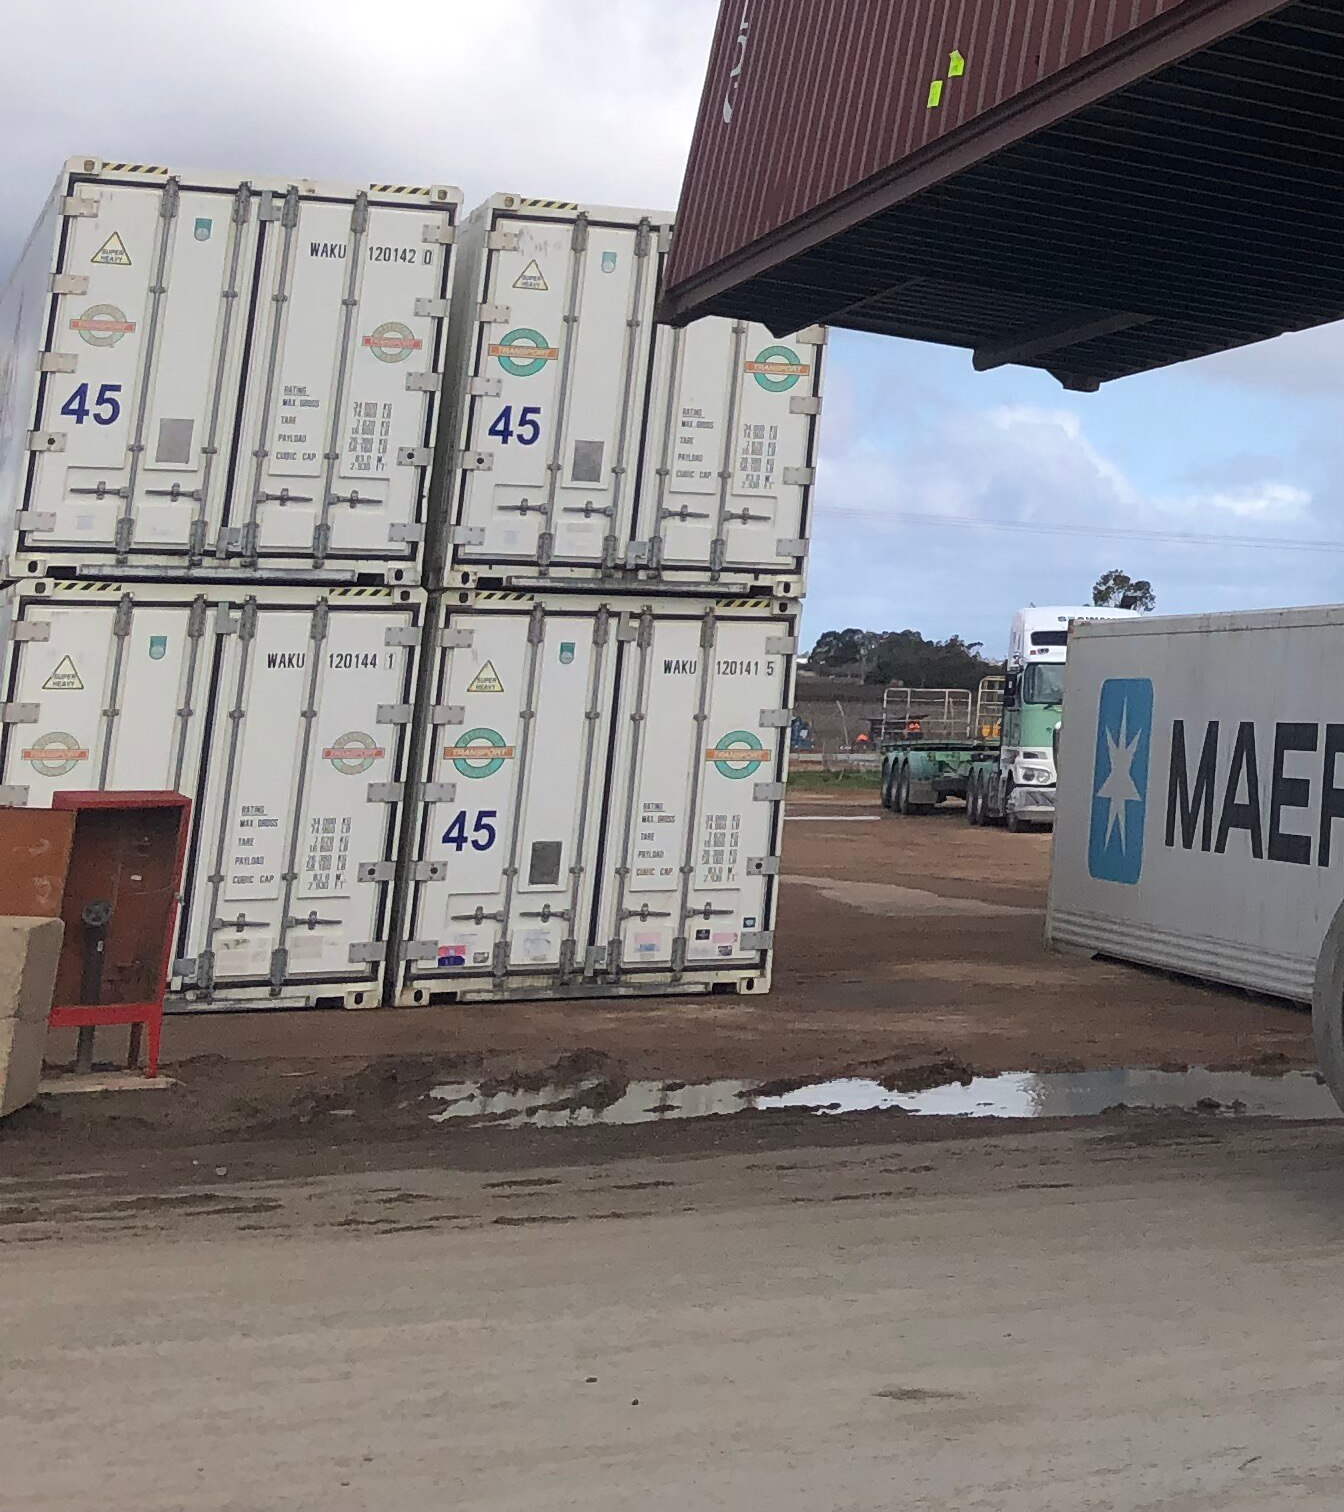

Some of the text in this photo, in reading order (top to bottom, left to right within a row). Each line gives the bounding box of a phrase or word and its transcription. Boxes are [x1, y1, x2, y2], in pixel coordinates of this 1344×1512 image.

[100, 255, 123, 263] HEAVY
[310, 242, 347, 259] WAKU
[368, 246, 416, 264] 120142
[61, 382, 122, 426] 45
[488, 405, 541, 446] 45
[267, 652, 306, 669] WAKU
[328, 653, 377, 669] 120144
[663, 659, 775, 676] WAKU 120141 5
[441, 810, 498, 852] 45
